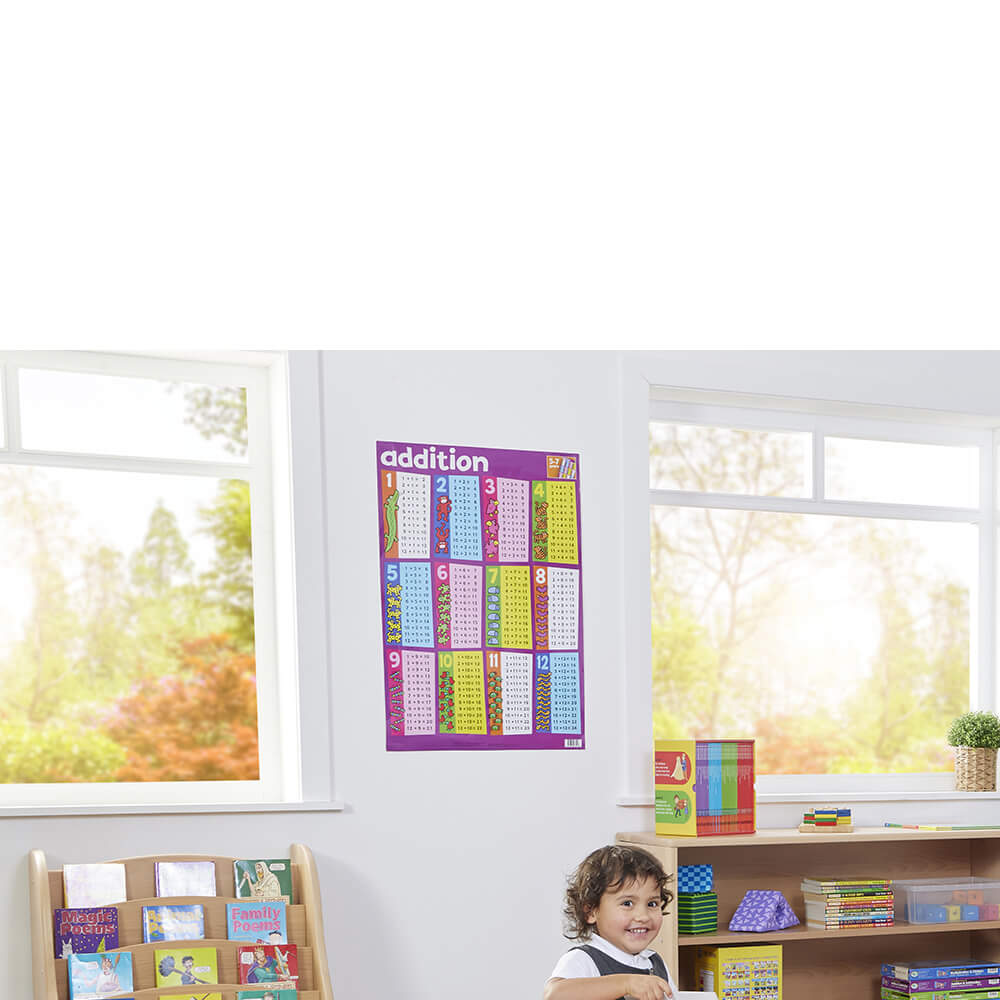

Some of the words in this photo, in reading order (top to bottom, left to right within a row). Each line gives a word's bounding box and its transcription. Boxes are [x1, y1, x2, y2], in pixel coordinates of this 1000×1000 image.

[380, 446, 489, 472] addition
[386, 472, 393, 488] 1
[436, 477, 447, 493] 2
[485, 478, 495, 494] 3
[534, 483, 545, 498] 4
[387, 564, 398, 581] 5
[437, 565, 448, 580] 6
[488, 567, 498, 584] 7
[535, 568, 546, 584] 8
[389, 651, 400, 668] 9
[439, 654, 452, 668] 10
[489, 653, 498, 668] 11
[537, 655, 549, 670] 12
[61, 910, 113, 926] Magic
[231, 906, 281, 921] Family
[60, 922, 115, 936] Poems
[233, 920, 281, 933] Poems
